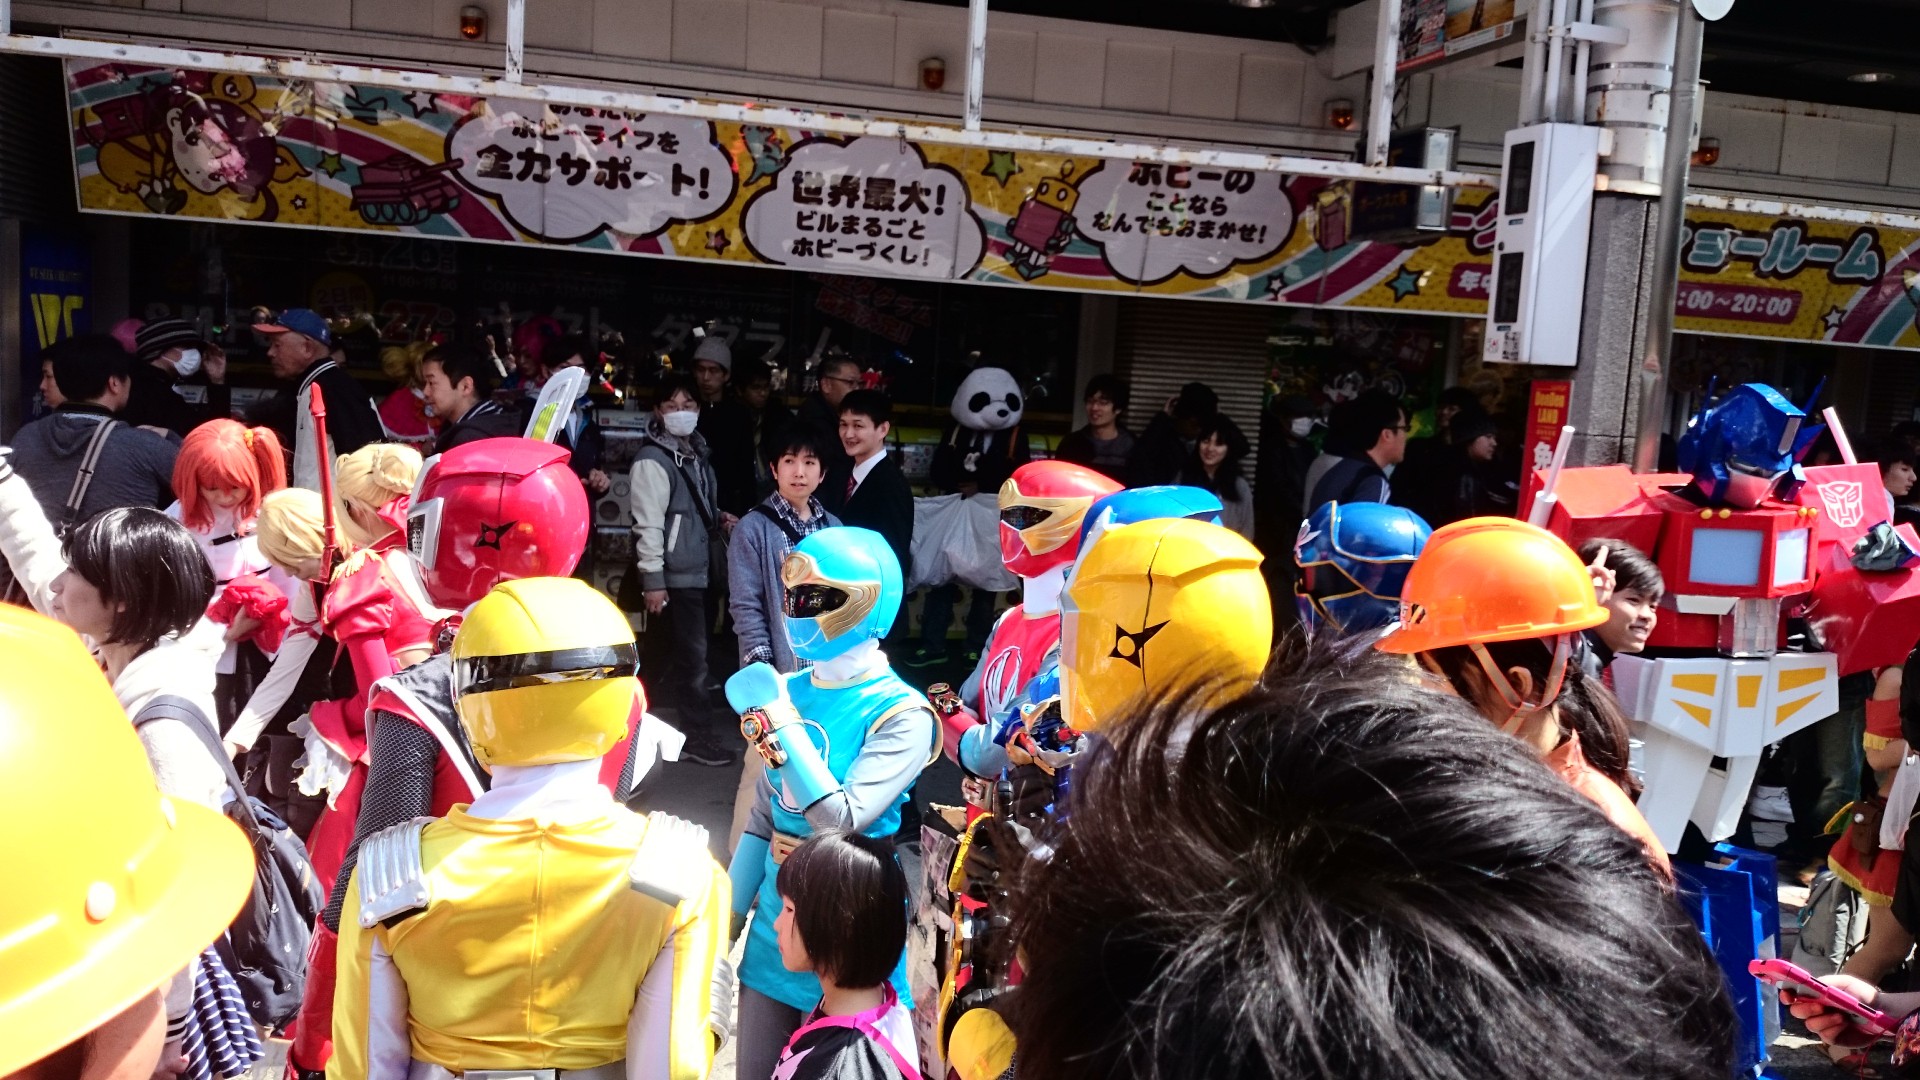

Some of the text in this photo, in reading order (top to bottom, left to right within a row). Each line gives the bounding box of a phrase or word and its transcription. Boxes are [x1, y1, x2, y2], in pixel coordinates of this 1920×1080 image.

[792, 170, 947, 216] 世界最大!
[1128, 161, 1255, 194] ホビーの
[1146, 192, 1228, 216] ことなら
[796, 210, 926, 240] ビルまるごと
[1092, 211, 1268, 244] なんでもおまかせ!
[791, 236, 930, 267] ホビーづくし!
[1681, 225, 1880, 281] ョールーム
[1537, 408, 1559, 425] LAND
